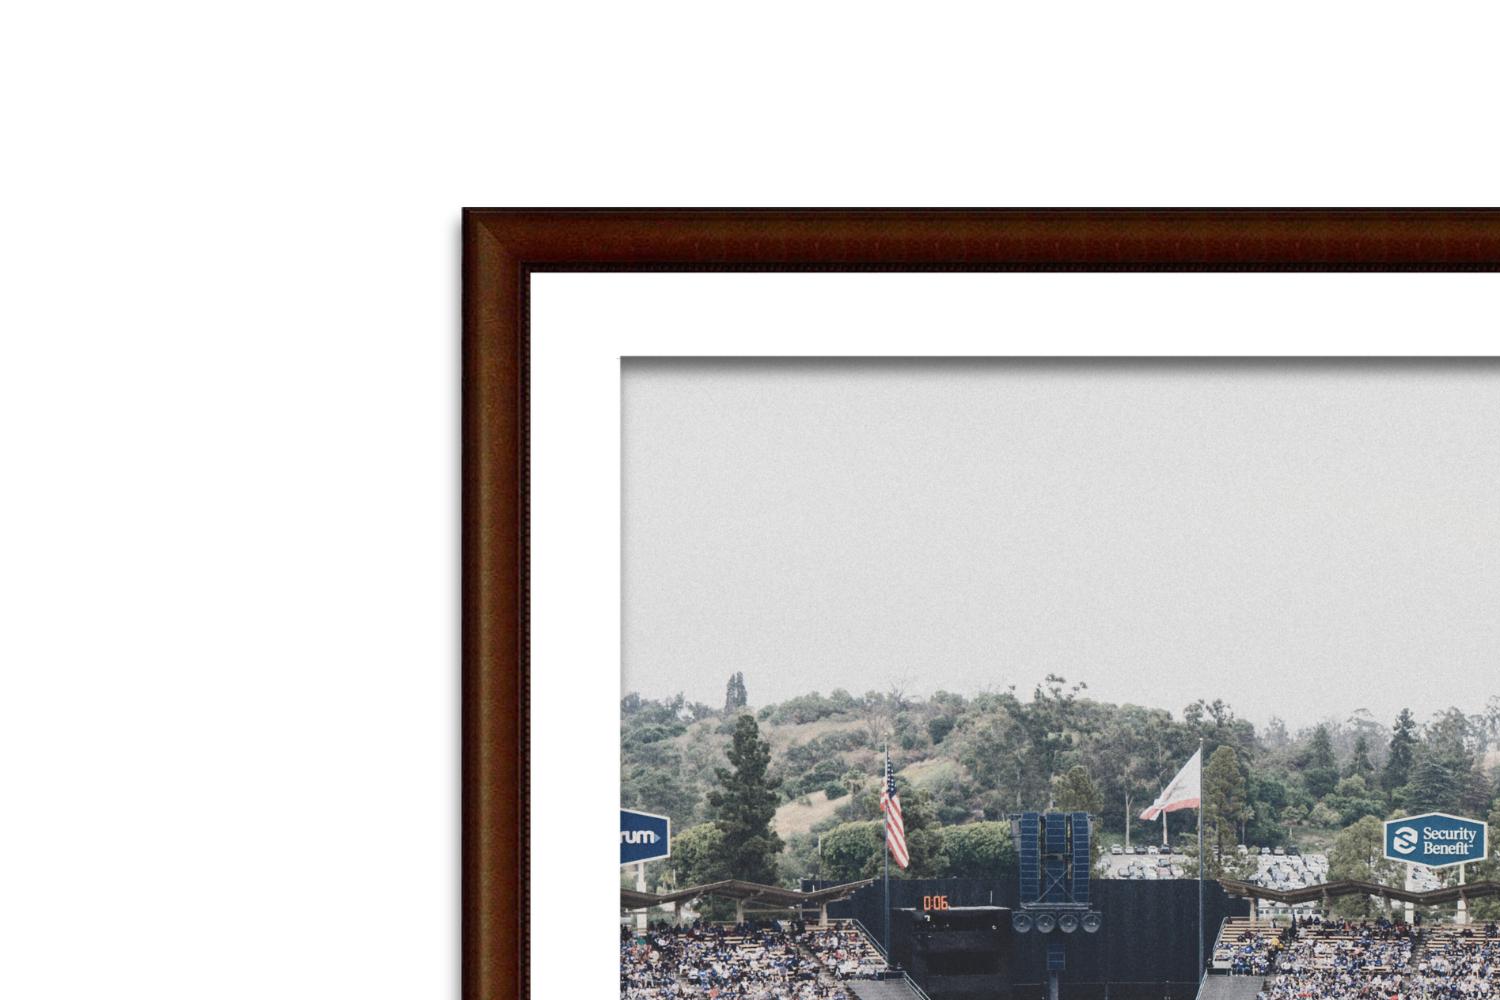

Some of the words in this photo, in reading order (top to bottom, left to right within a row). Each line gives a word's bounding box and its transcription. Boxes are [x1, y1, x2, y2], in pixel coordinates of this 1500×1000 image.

[619, 830, 655, 844] rum
[1423, 826, 1477, 843] Security
[1423, 841, 1469, 855] Benefit
[923, 895, 948, 911] 0:06
